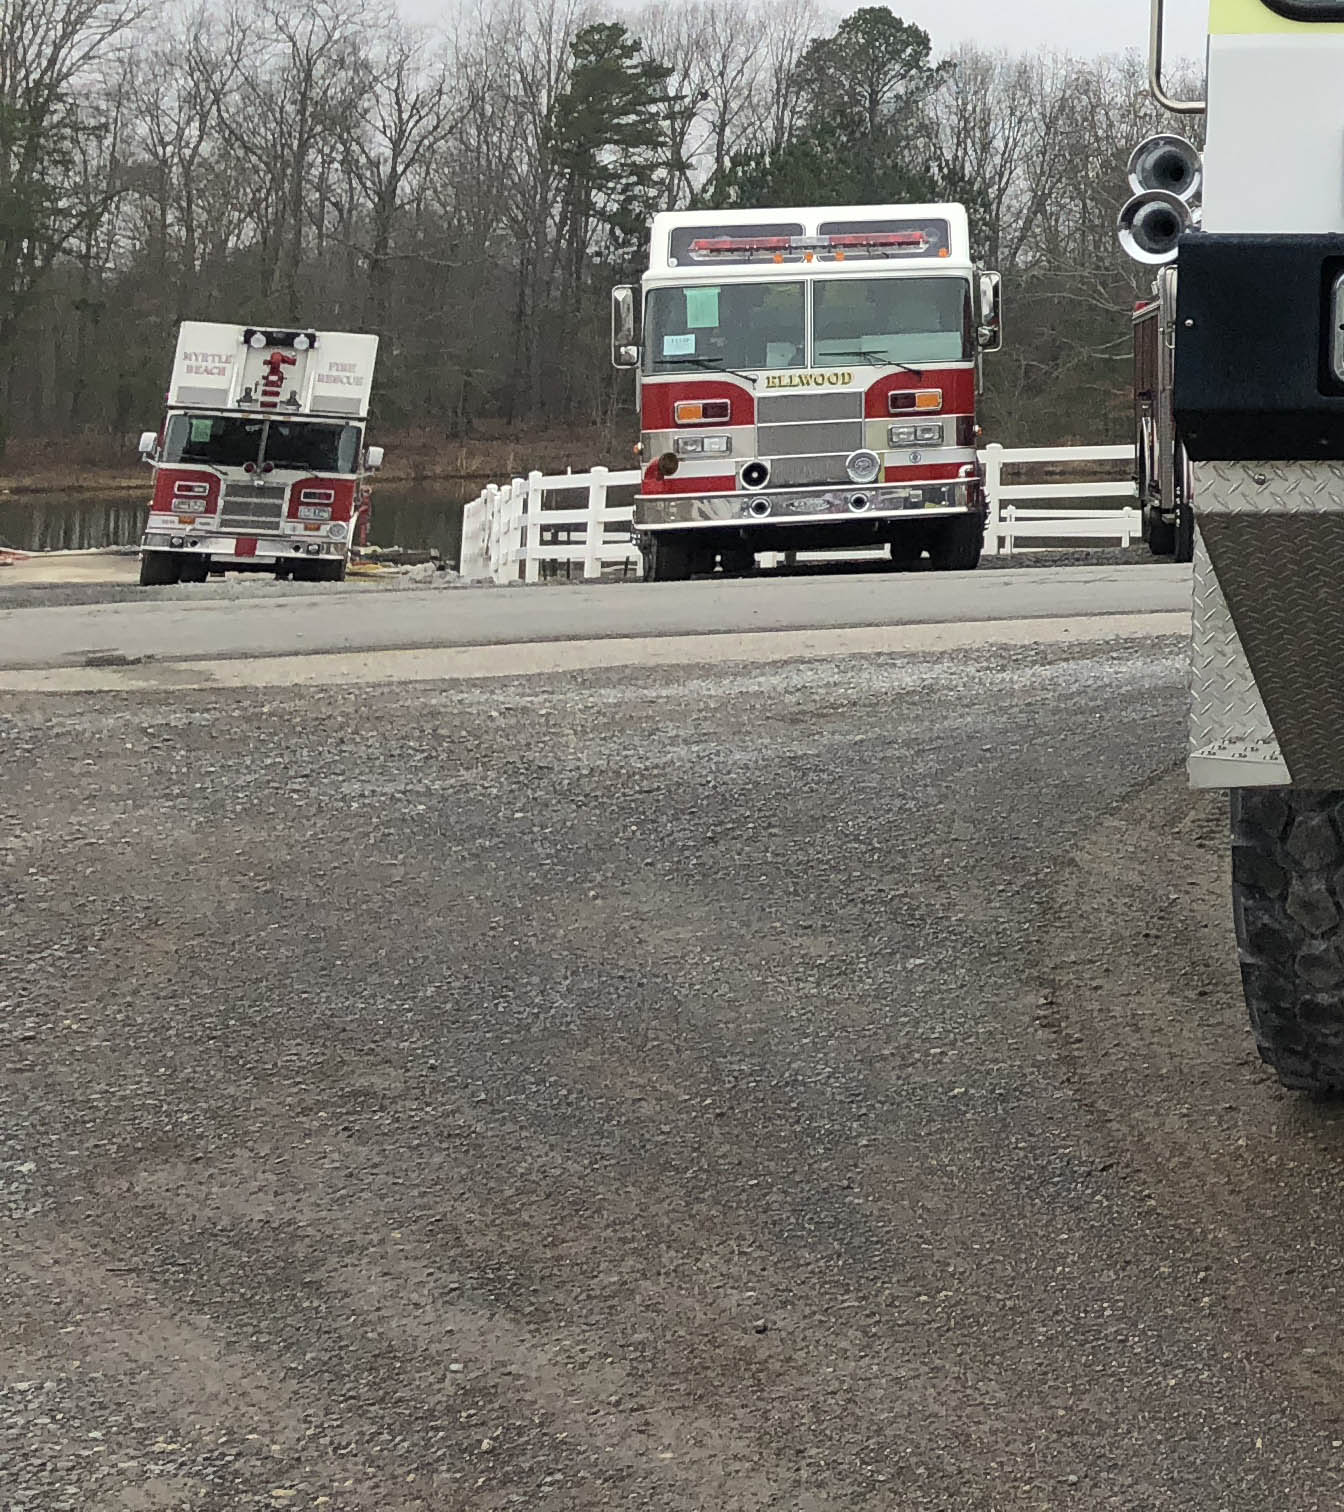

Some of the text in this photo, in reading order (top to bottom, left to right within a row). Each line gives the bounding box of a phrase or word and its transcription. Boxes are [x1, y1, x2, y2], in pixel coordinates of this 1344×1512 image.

[183, 351, 233, 365] MYRTLE
[185, 364, 226, 377] BEACH
[765, 372, 854, 389] ELLWOOD
